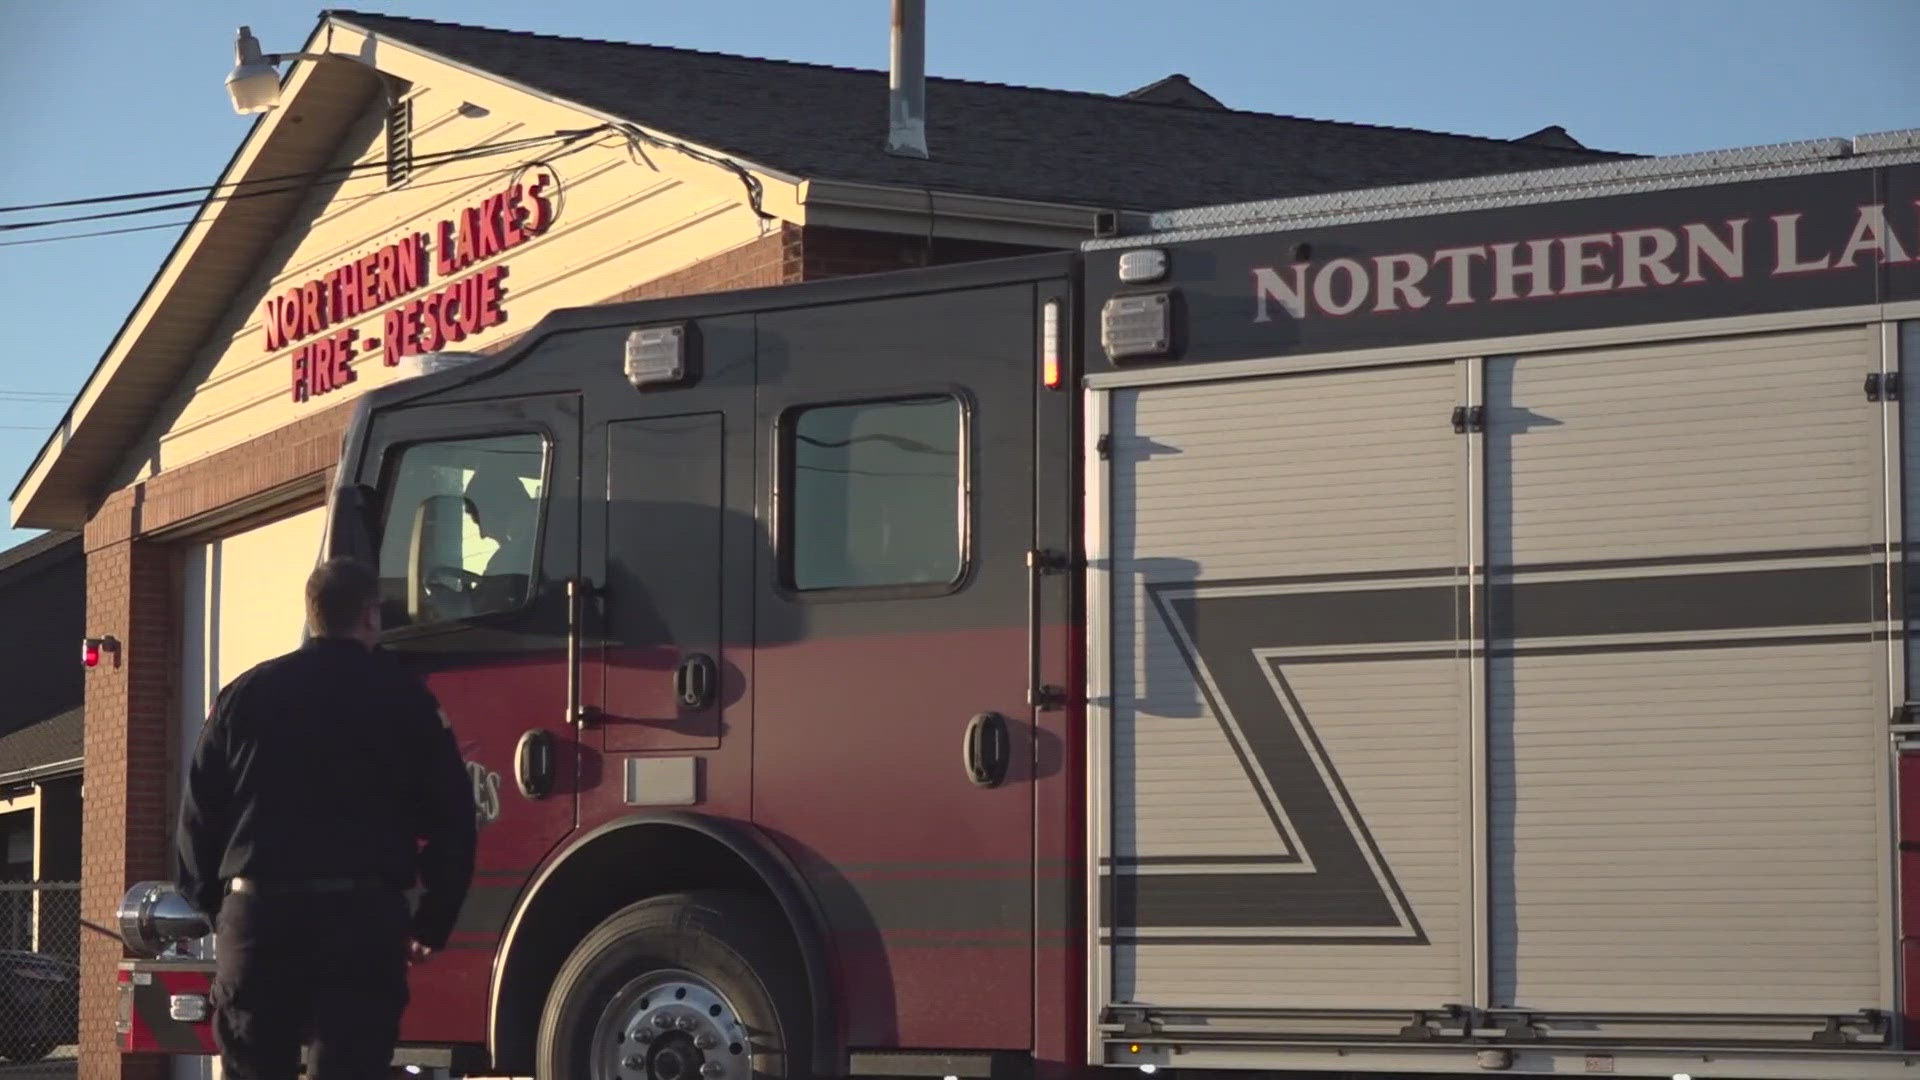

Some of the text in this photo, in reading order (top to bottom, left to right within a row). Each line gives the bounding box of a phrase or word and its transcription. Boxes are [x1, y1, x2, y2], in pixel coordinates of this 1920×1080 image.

[262, 174, 552, 351] NORTHERN LAKES
[1251, 200, 1920, 324] NORTHERN LA
[465, 761, 501, 821] ES
